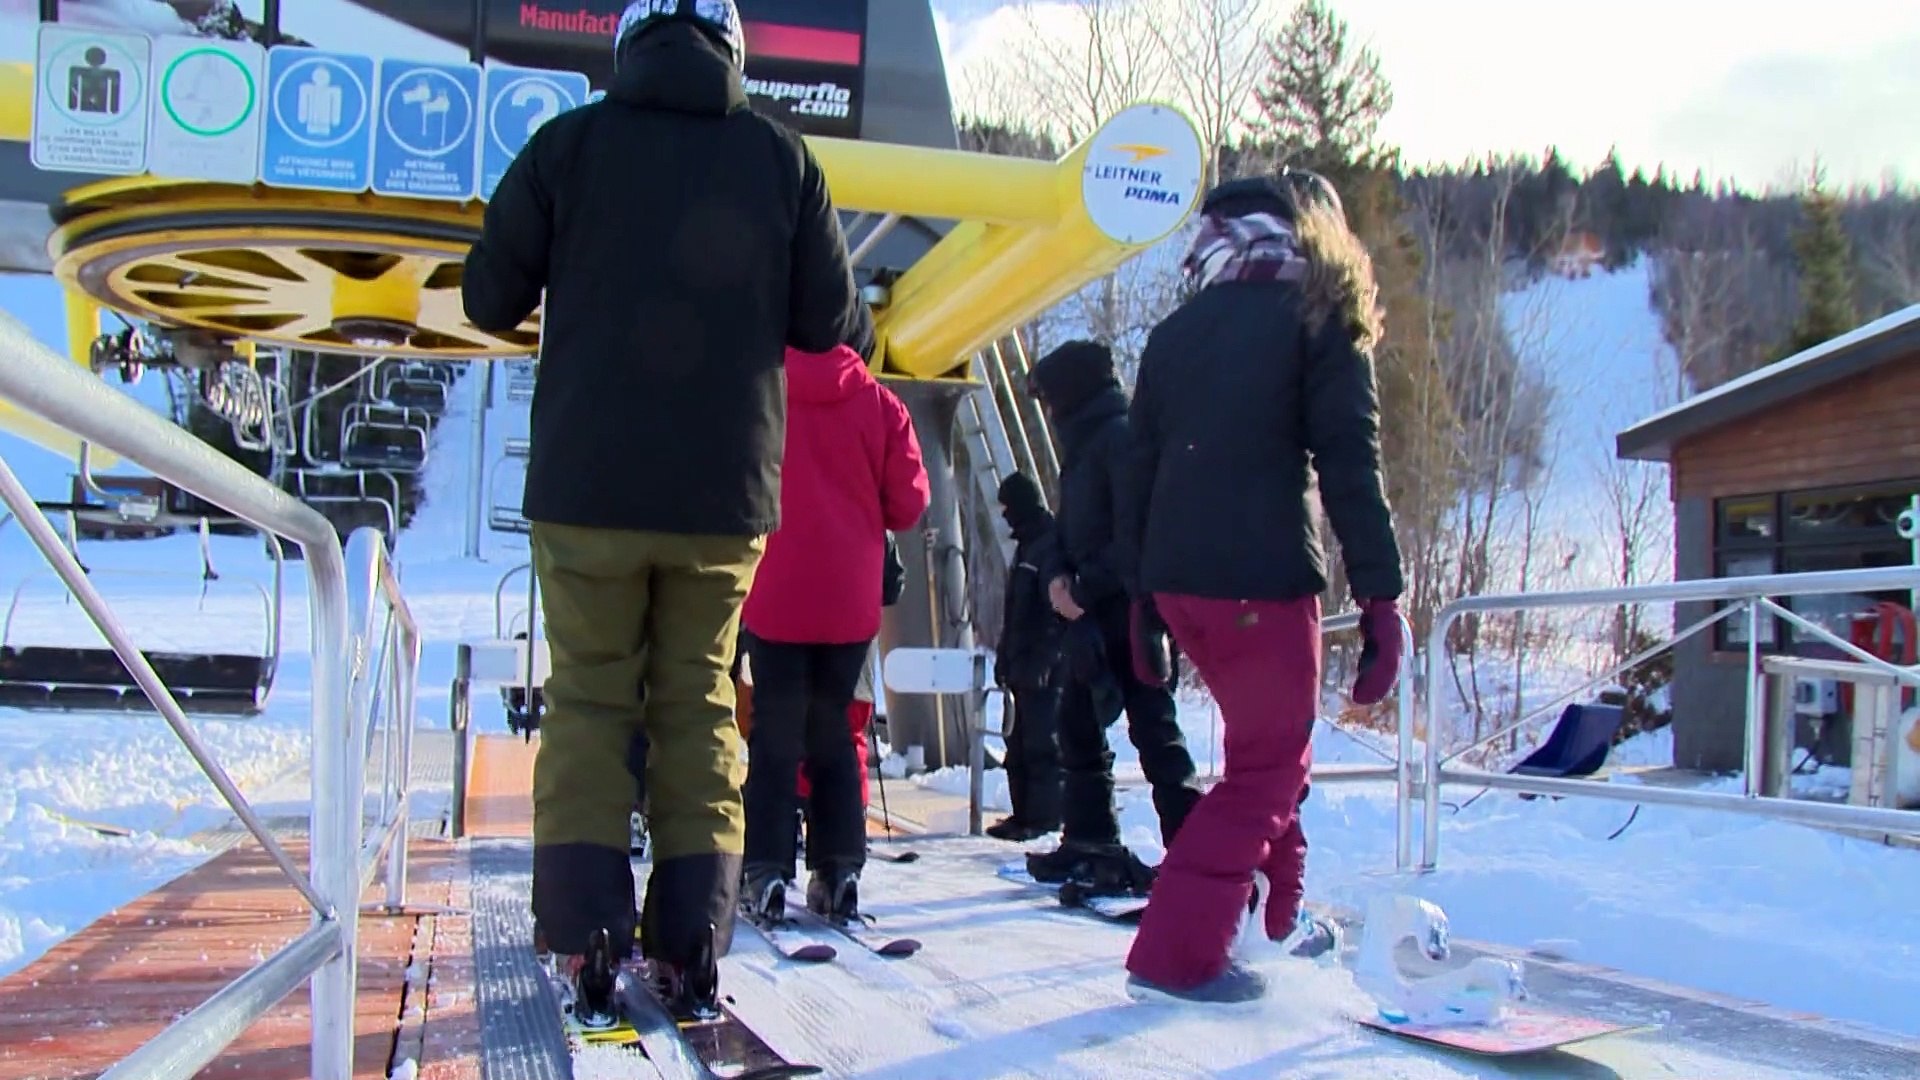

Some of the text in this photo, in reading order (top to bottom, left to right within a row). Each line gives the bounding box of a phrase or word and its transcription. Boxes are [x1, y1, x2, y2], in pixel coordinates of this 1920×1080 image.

[743, 75, 852, 102] superflo
[1095, 164, 1162, 186] LEITNER
[1124, 186, 1180, 206] POMA
